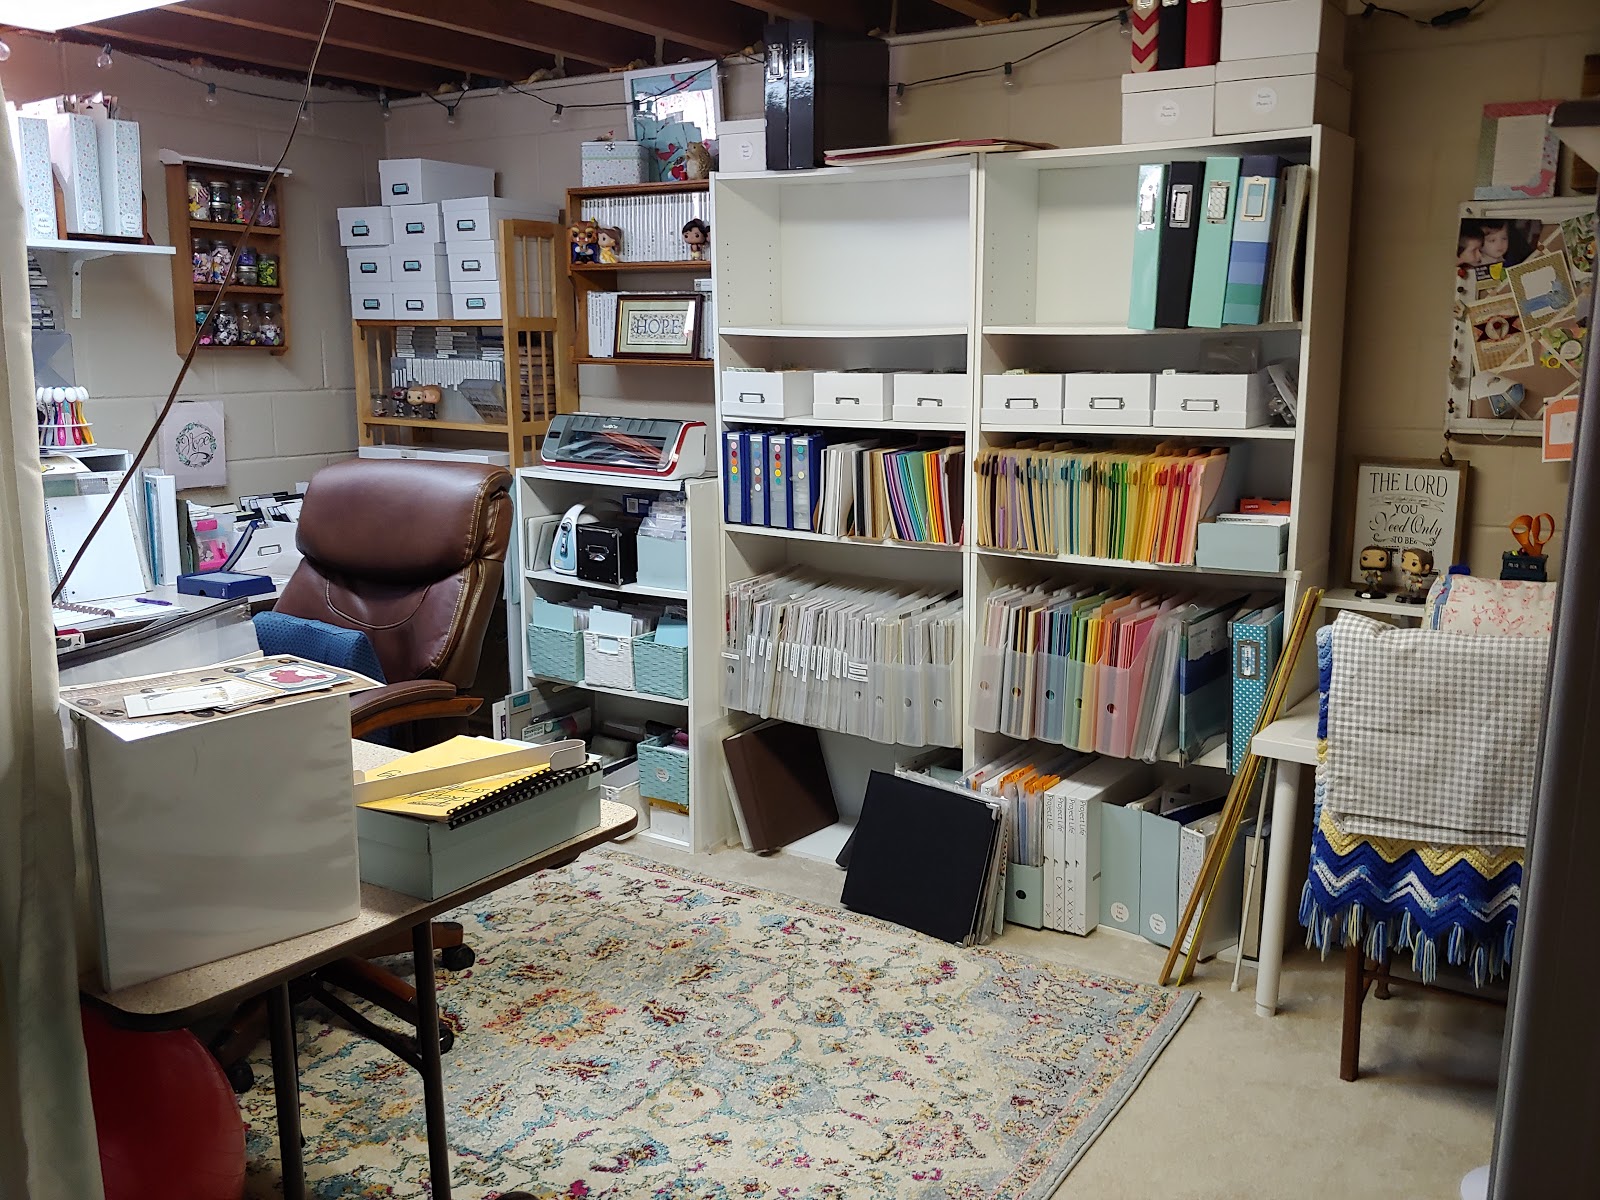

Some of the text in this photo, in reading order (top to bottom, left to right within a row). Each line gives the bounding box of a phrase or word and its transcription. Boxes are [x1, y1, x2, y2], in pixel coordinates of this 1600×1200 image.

[636, 318, 680, 335] HOPE
[1370, 472, 1448, 498] THE LORD
[1394, 504, 1418, 515] YOU
[1369, 511, 1442, 542] Need Only
[1392, 536, 1403, 544] TO
[1046, 794, 1054, 817] Project
[1056, 797, 1064, 820] Project
[1068, 799, 1076, 821] Project
[1079, 801, 1087, 823] Project
